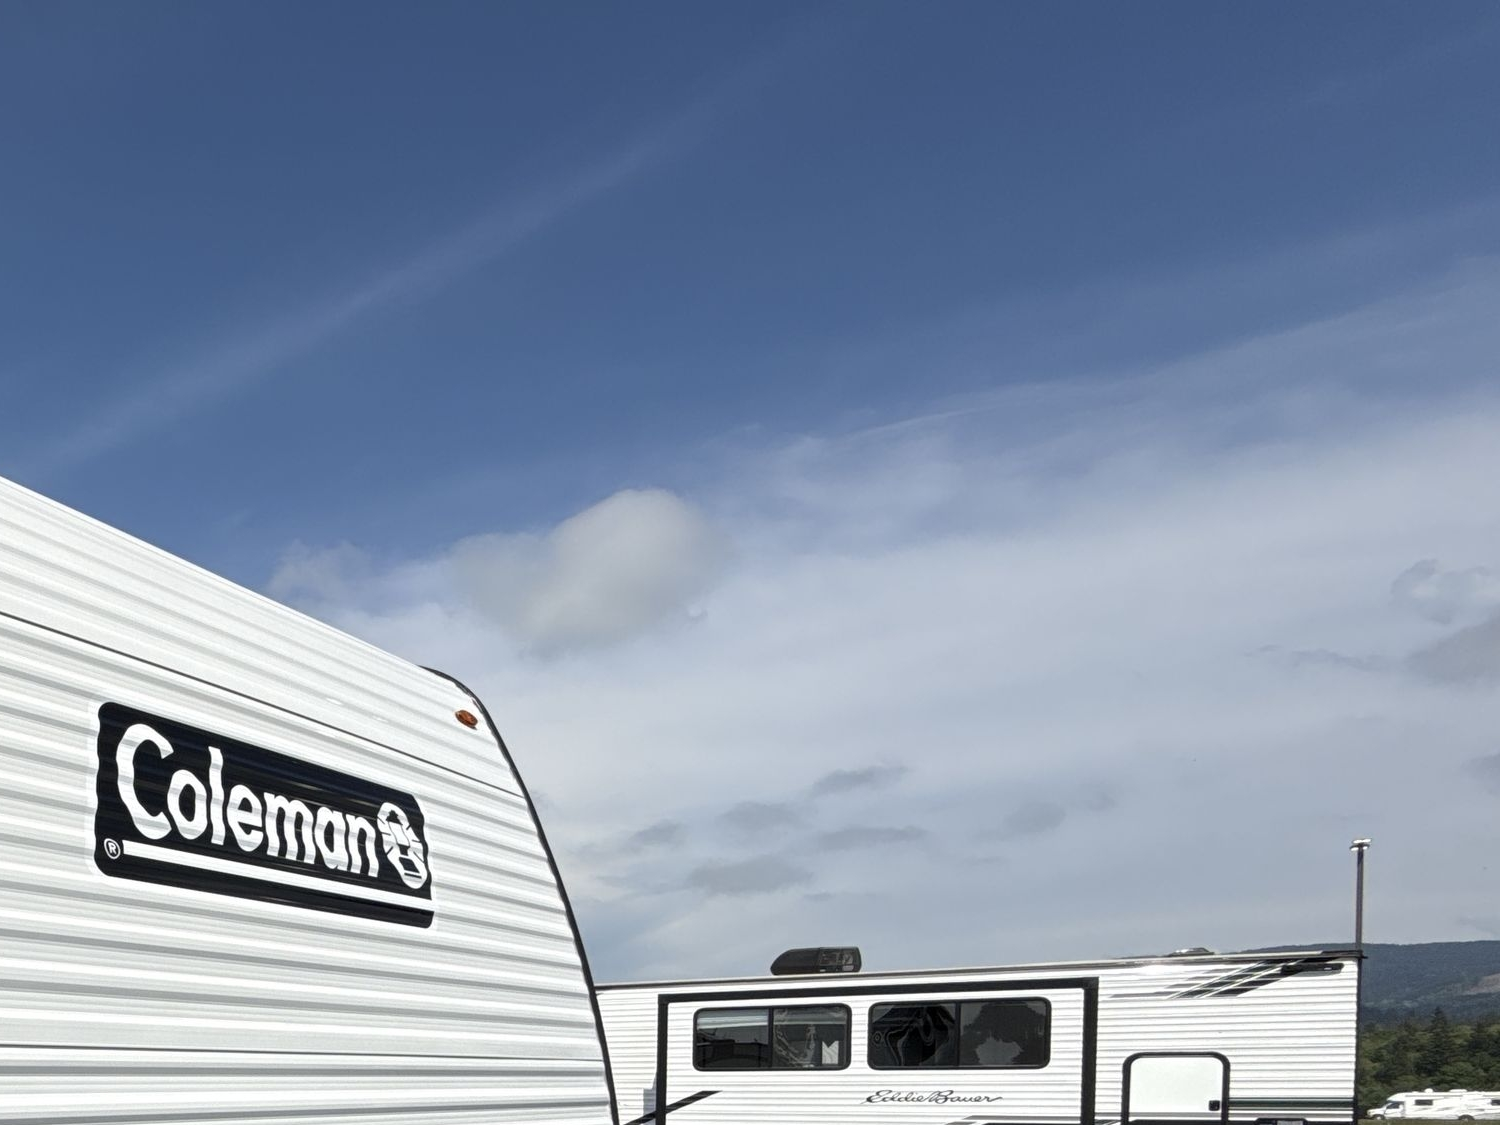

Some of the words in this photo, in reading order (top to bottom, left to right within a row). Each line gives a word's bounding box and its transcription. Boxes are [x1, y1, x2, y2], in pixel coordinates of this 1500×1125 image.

[115, 722, 379, 878] Coleman
[861, 1089, 931, 1104] Eddie
[928, 1089, 1003, 1104] Bauer
